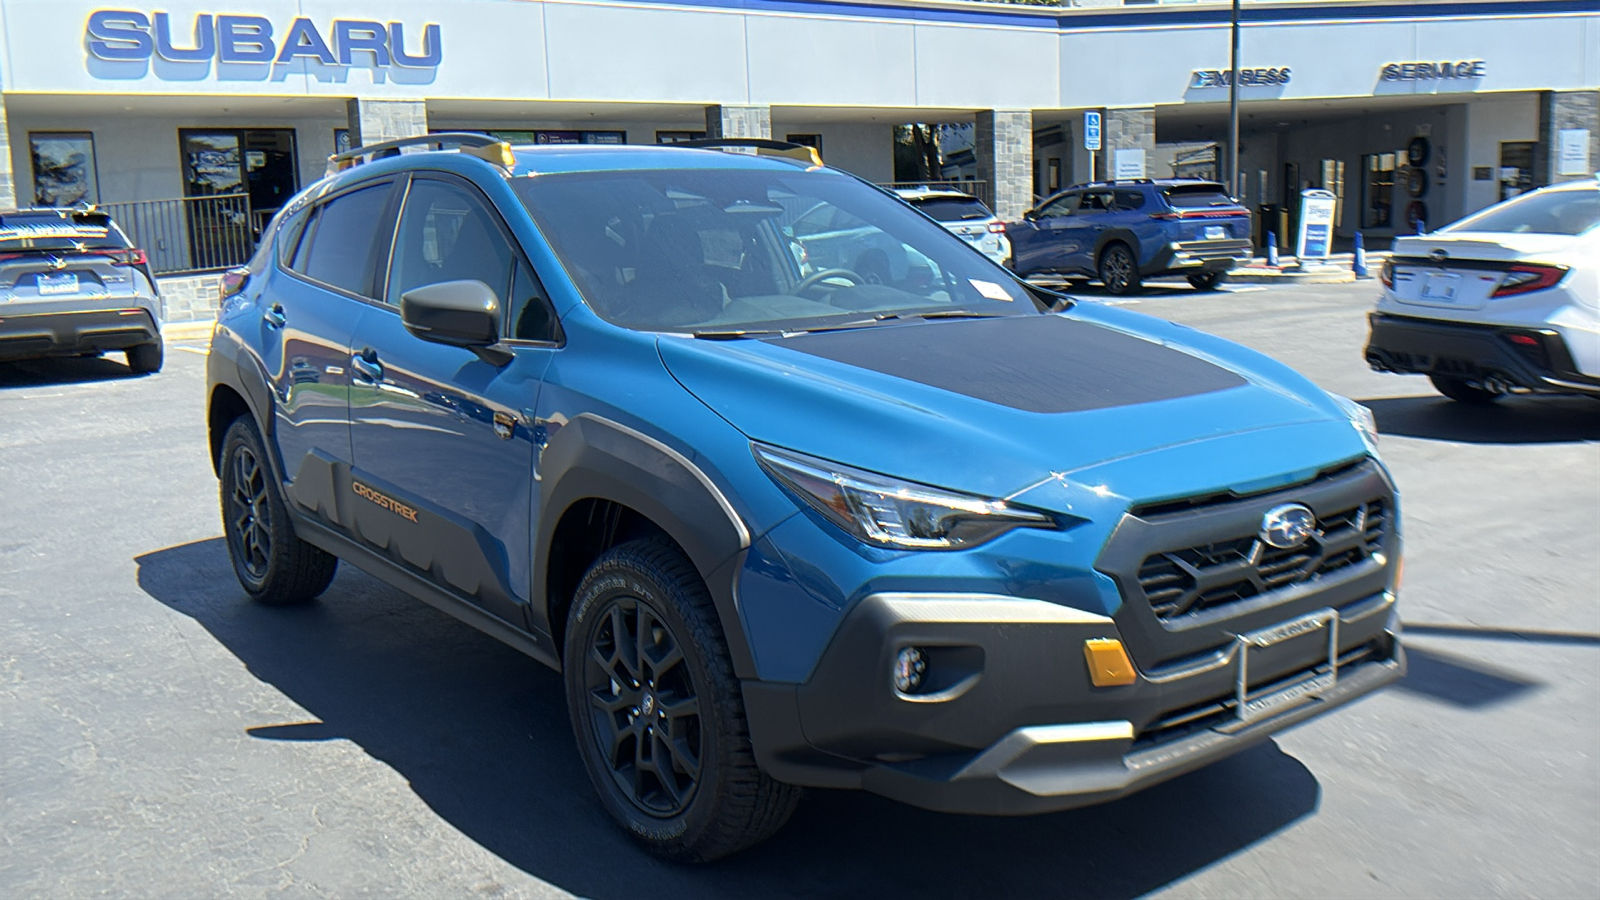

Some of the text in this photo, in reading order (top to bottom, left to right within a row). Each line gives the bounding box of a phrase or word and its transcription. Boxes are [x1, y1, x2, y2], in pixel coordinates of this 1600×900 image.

[87, 9, 442, 68] SUBARU
[1381, 61, 1486, 80] SERVICE
[353, 481, 418, 523] CROSSTREK
